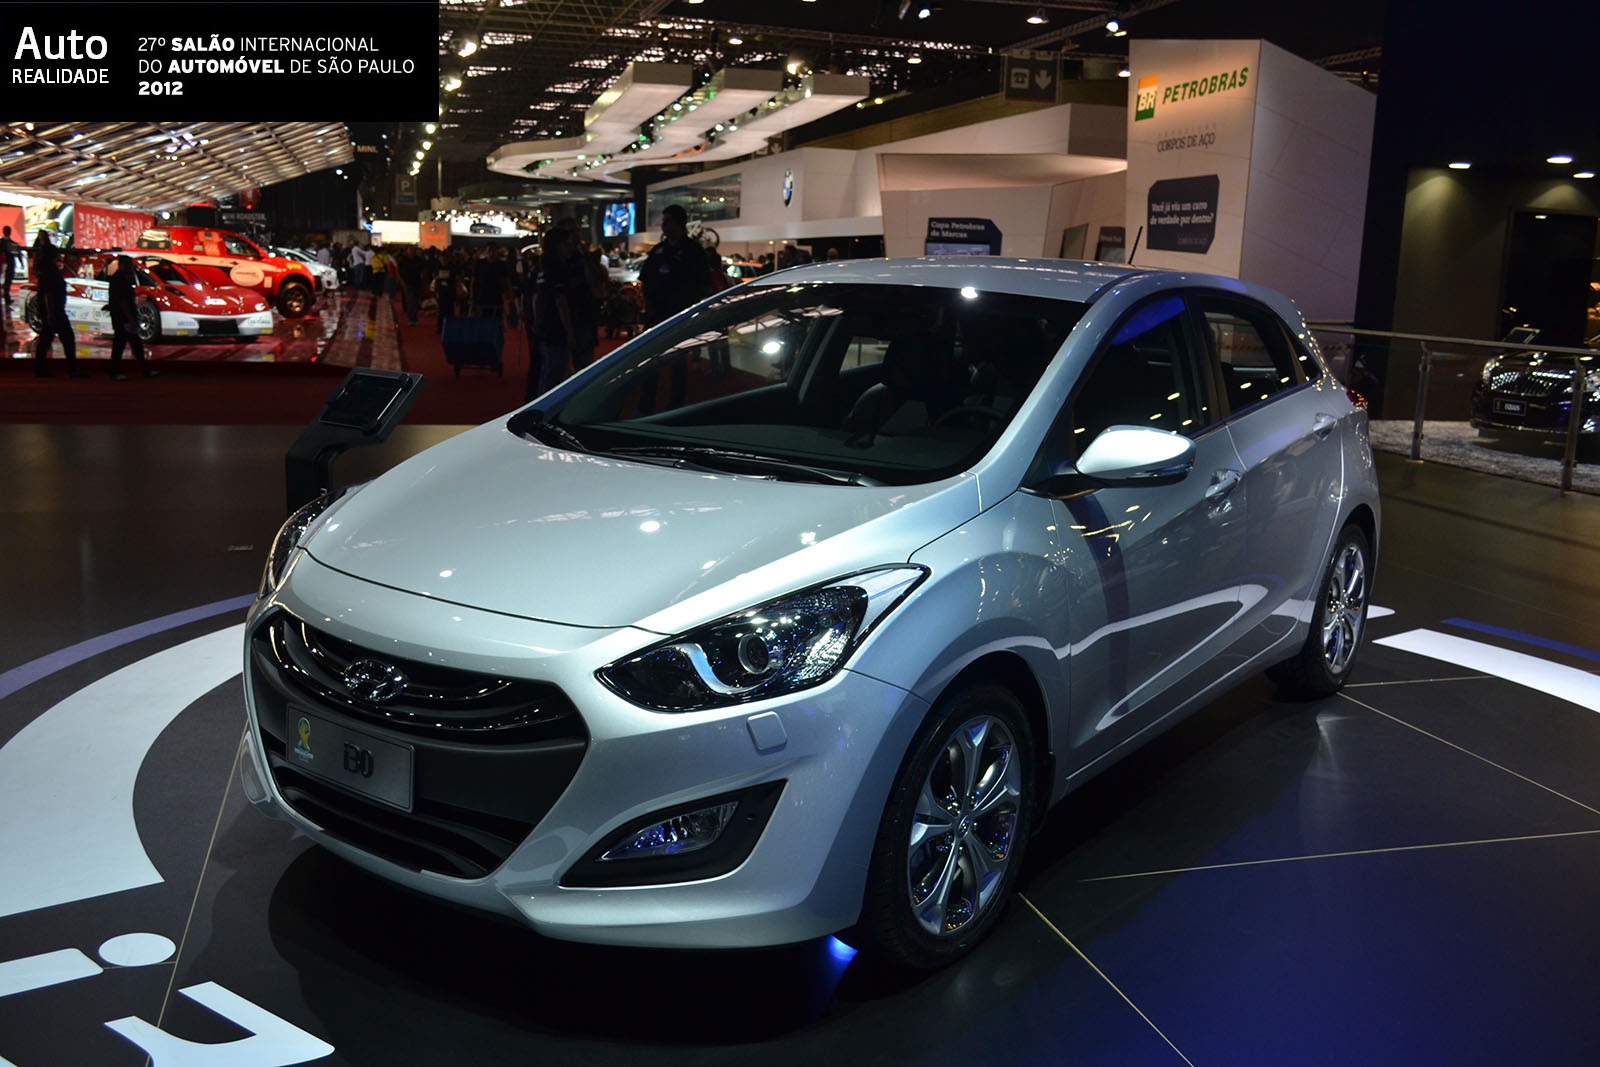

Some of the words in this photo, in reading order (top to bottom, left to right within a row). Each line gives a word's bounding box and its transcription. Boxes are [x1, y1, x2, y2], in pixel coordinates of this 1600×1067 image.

[1162, 66, 1249, 105] PETROBRAS
[931, 221, 950, 230] Copa
[941, 230, 968, 238] Marcas
